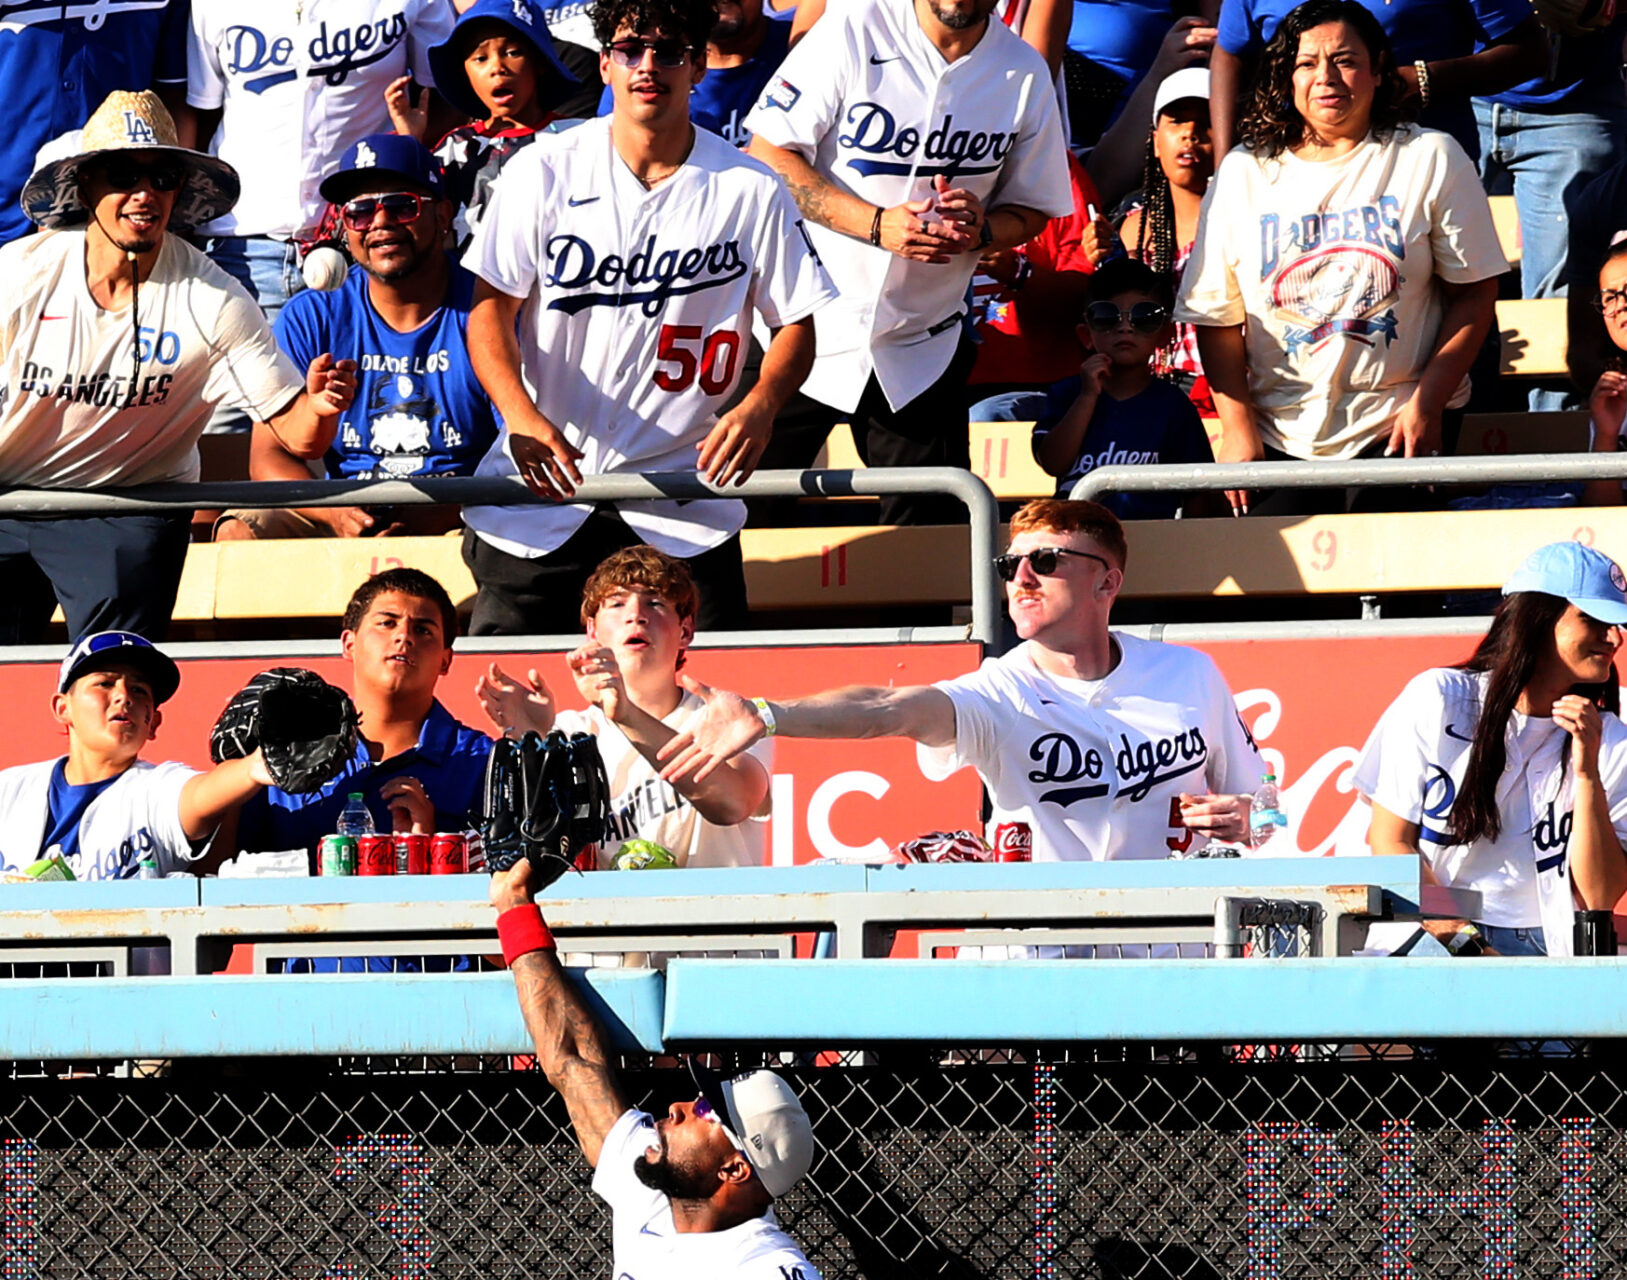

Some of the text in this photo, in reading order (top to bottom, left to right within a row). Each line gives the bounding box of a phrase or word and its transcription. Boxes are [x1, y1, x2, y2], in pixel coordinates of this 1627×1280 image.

[226, 12, 407, 87] Dodgers
[123, 111, 158, 144] LA
[838, 102, 1019, 190] Dodger
[355, 141, 377, 169] LA
[1260, 195, 1406, 284] DDGERS
[545, 234, 748, 318] Dodgers
[132, 326, 181, 366] 50
[413, 350, 450, 374] LOS
[652, 324, 740, 397] 50
[57, 373, 173, 410] ANGELES
[342, 422, 361, 448] LA
[442, 421, 463, 448] LA
[983, 438, 1009, 478] 11
[820, 544, 846, 588] 11
[1310, 530, 1337, 571] 9
[1029, 726, 1208, 802] Dodgers
[999, 826, 1032, 853] Coca
